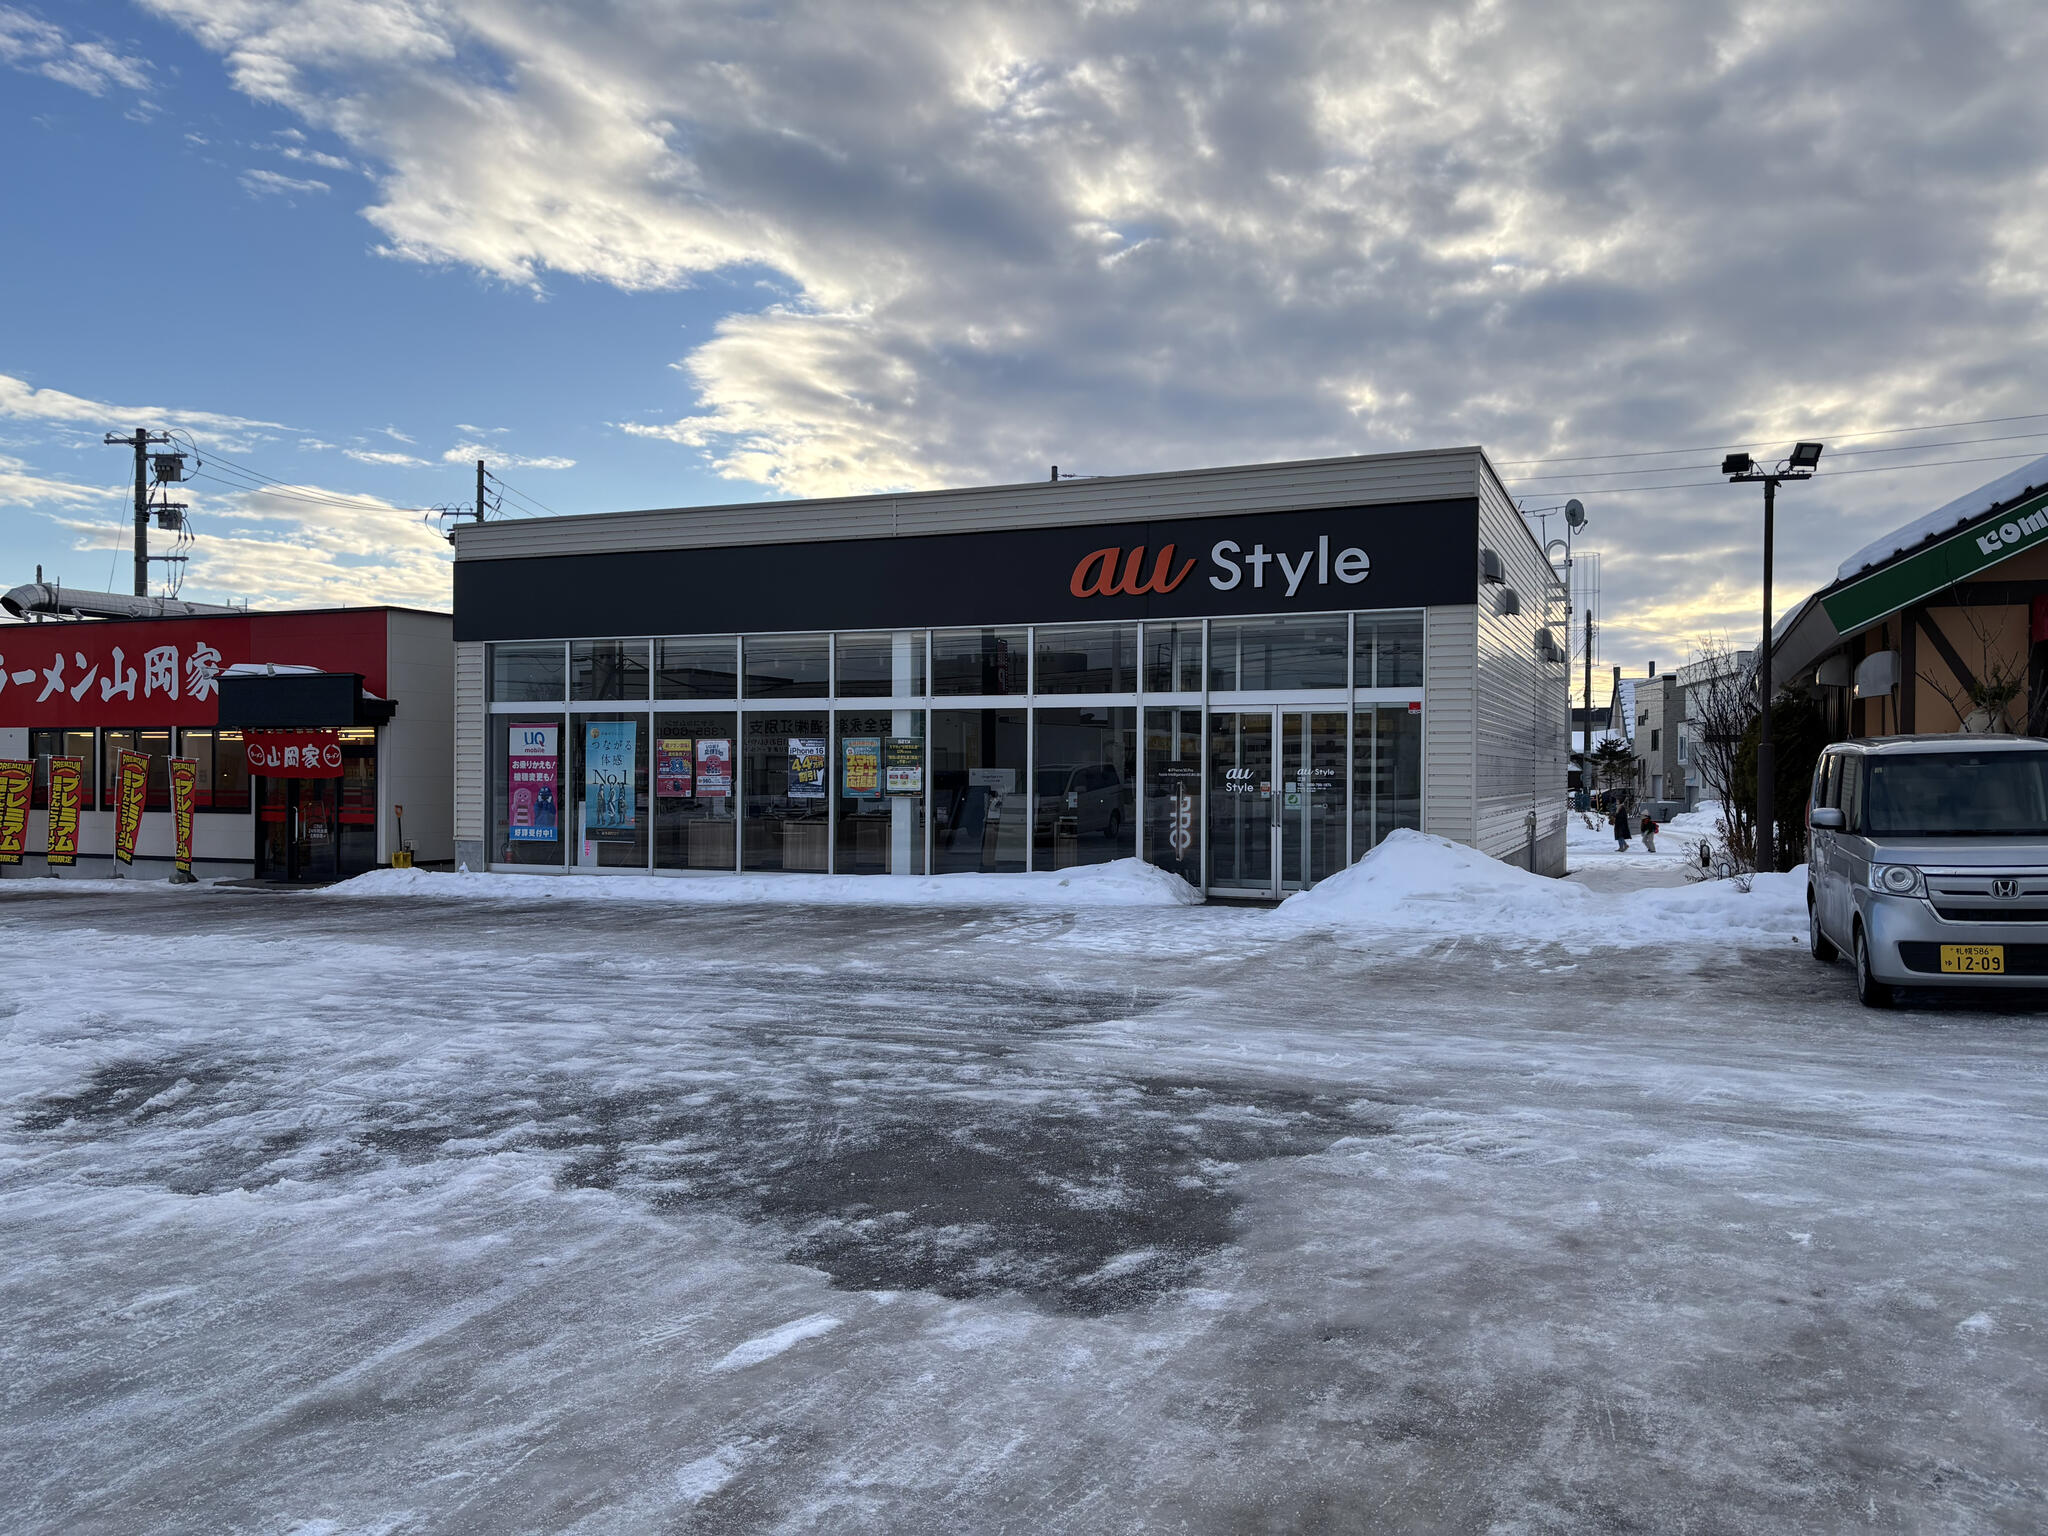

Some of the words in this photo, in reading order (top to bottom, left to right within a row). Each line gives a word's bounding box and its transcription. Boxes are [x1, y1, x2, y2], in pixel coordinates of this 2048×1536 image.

[1070, 543, 1197, 598] au
[1209, 535, 1371, 597] Style
[524, 731, 545, 747] UQ
[591, 740, 633, 751] つながる
[267, 743, 321, 769] 山岡家
[790, 747, 814, 755] iPhone
[816, 747, 824, 755] 16
[53, 760, 82, 773] PREMIUM
[601, 754, 623, 767] 体感
[592, 769, 628, 785] No.1
[1225, 768, 1254, 780] au
[1297, 768, 1314, 776] au
[1315, 768, 1335, 777] Style
[1226, 782, 1254, 794] Style
[1, 775, 31, 851] プレミアム
[55, 774, 81, 852] プレミアム
[126, 772, 146, 850] プレミアム
[178, 777, 195, 859] プレミアム
[1957, 957, 2000, 971] 12-09
